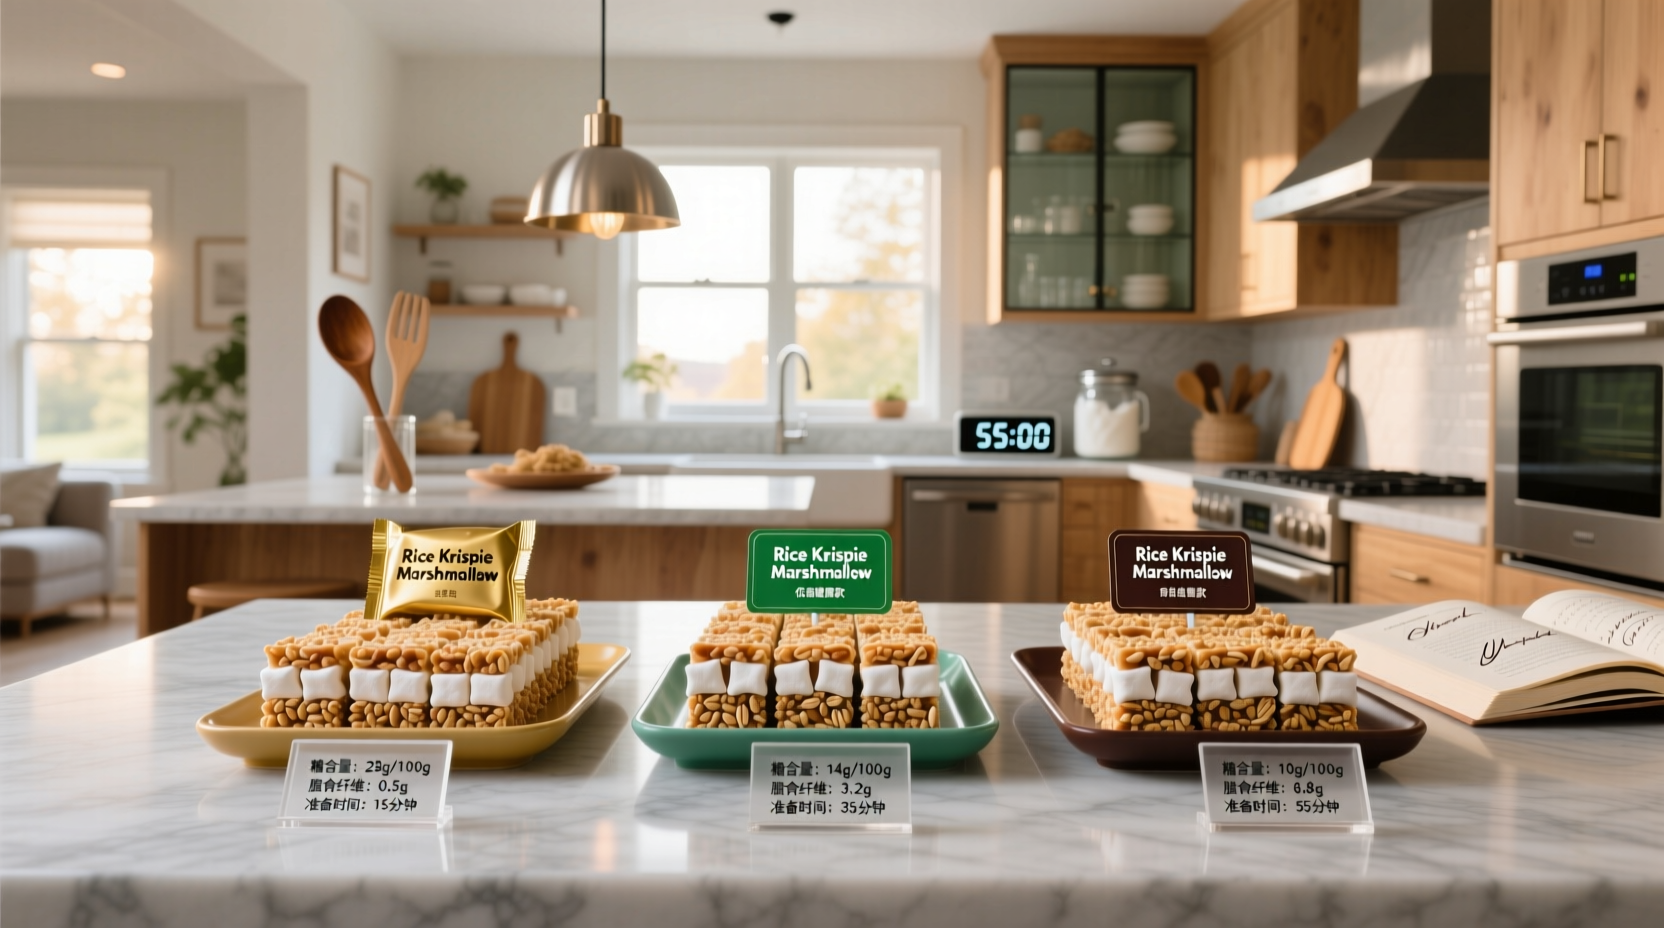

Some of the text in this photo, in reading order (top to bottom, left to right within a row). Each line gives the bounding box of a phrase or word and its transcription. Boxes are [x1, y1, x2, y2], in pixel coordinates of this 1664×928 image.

[976, 421, 1051, 450] 55:00
[402, 548, 494, 565] Rice Krispie
[773, 546, 868, 564] Rice Krispie
[1135, 546, 1227, 564] Rice Krispie
[1132, 563, 1233, 580] Marshmallow
[827, 761, 891, 779] 14g/100g
[1279, 762, 1344, 778] 10g/100g
[378, 780, 408, 795] 0.5g
[841, 782, 871, 798] 3.2g
